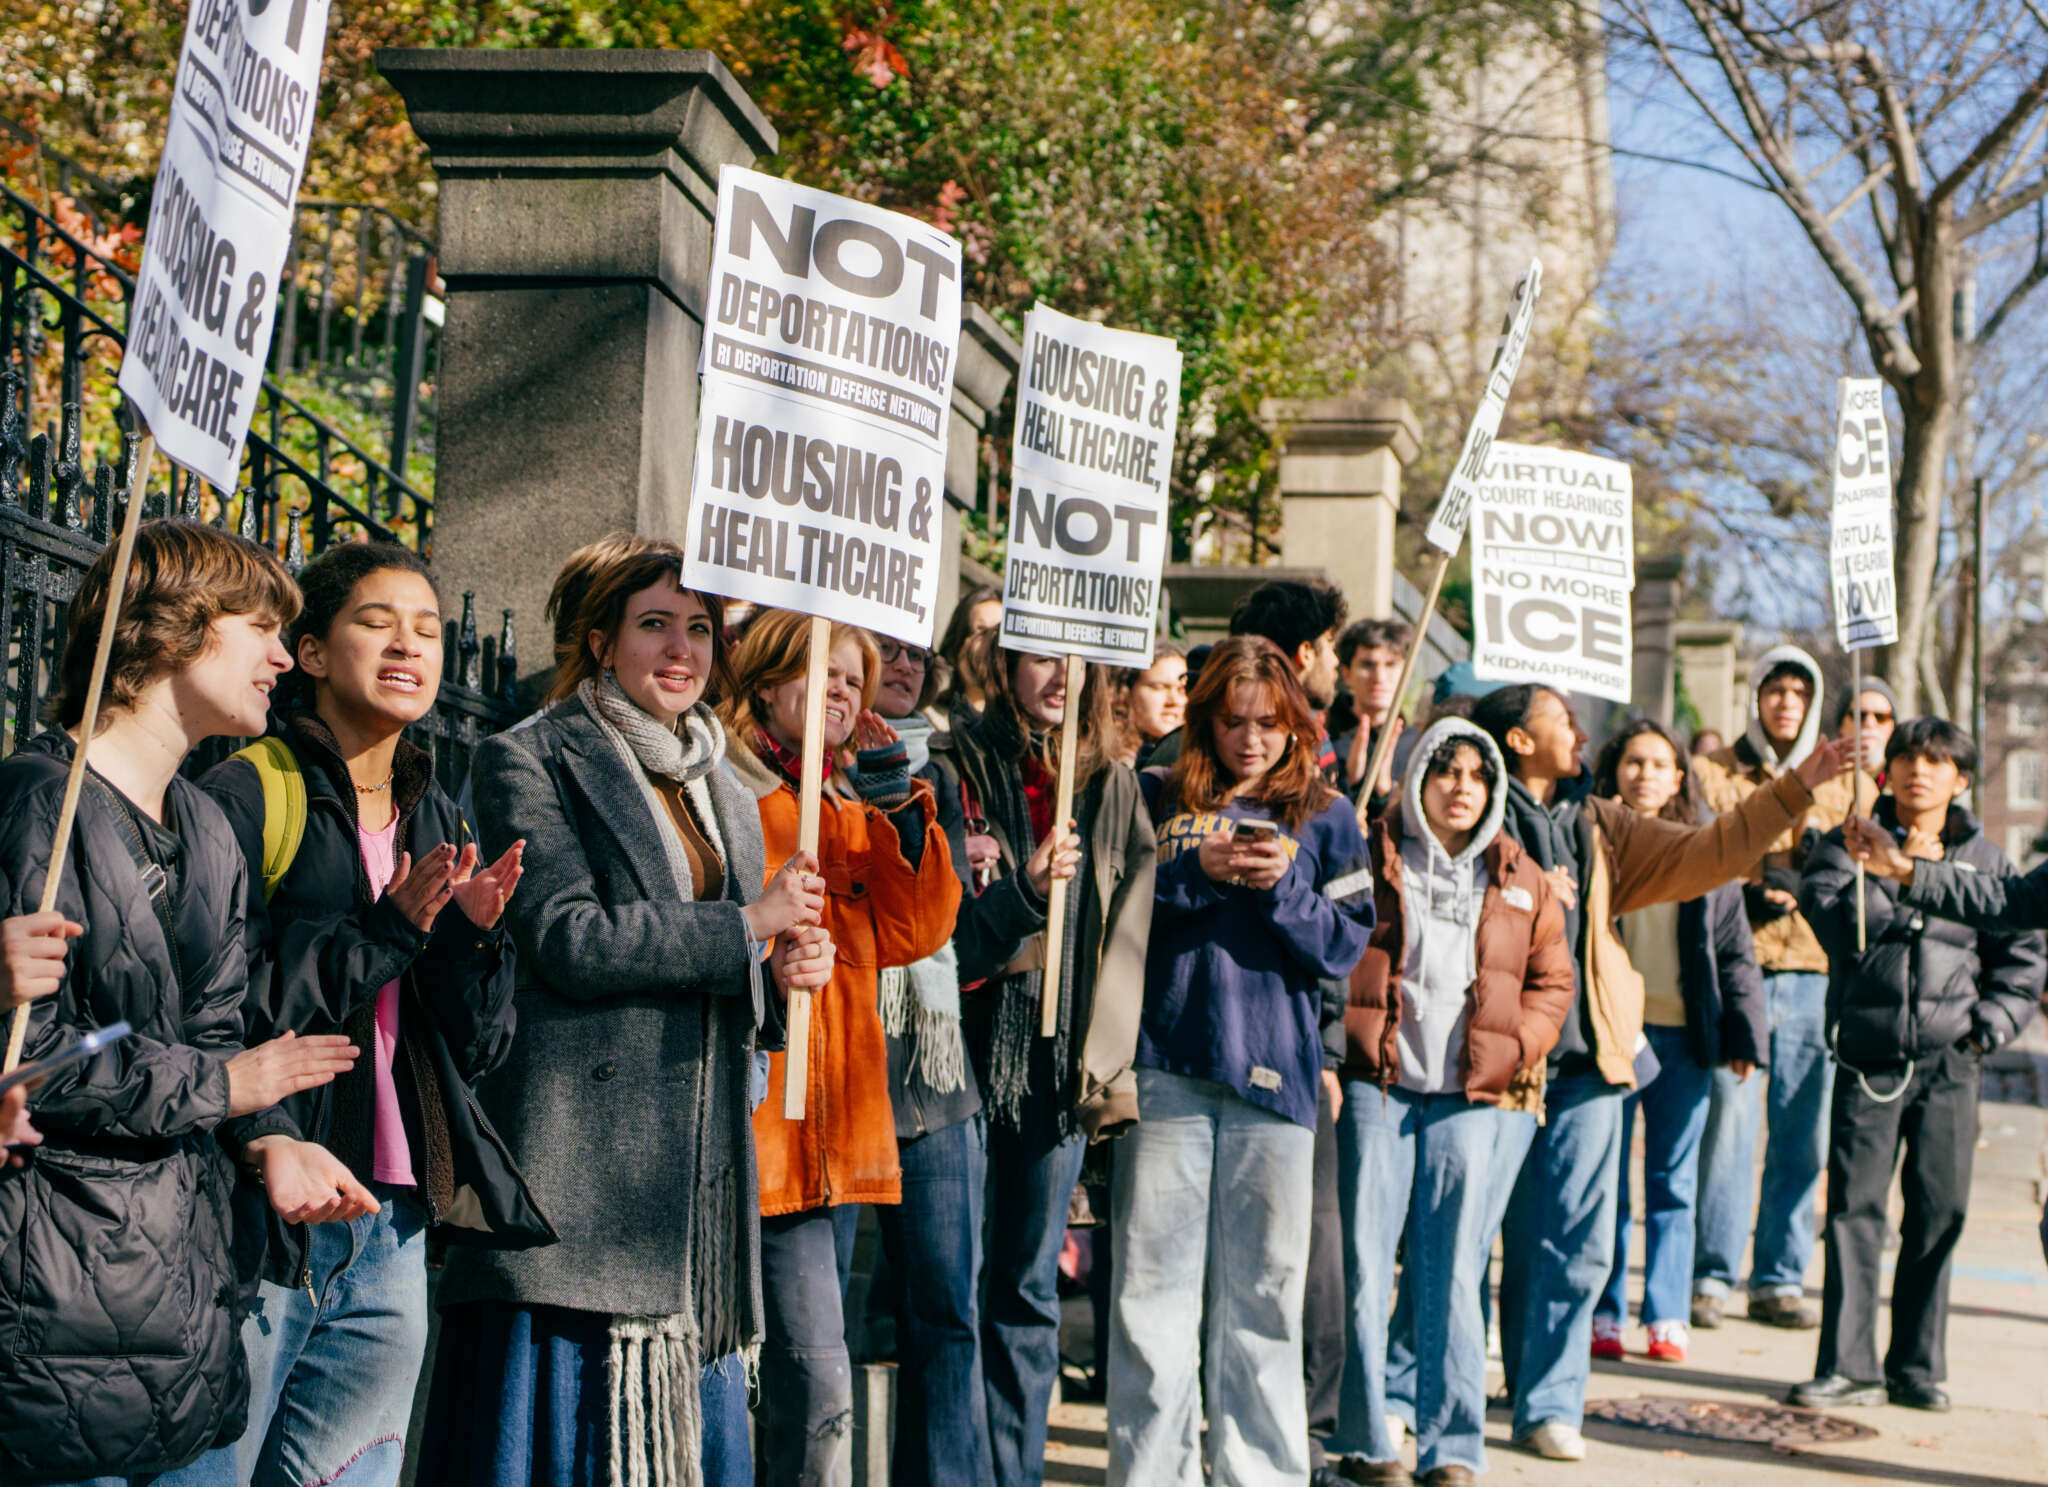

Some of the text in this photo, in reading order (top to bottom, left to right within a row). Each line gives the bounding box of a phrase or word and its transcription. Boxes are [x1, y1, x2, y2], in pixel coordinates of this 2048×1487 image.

[195, 0, 309, 153] DEPTIONS!
[728, 185, 956, 322] NOT
[235, 271, 266, 358] &
[718, 272, 950, 395] DEPORTATIONS!
[716, 342, 938, 433] RI DEPORTATION DEFENSE NETWORK
[1029, 331, 1168, 430] HOUSING &
[711, 415, 934, 544] HOUSING &
[1020, 400, 1162, 494] HEALTHCARE,
[1481, 461, 1625, 494] VIRTUAL
[1839, 418, 1885, 479] CE
[1014, 487, 1158, 563] NOT
[1478, 485, 1624, 518] COURT HEARINGS
[1482, 509, 1625, 556] NOW!
[698, 502, 925, 624] HEALTHCARE,
[1008, 558, 1154, 619] DEPORTATIONS!
[1482, 568, 1624, 608] NO MORE
[1064, 622, 1103, 645] DEFENSE
[1484, 593, 1624, 667] ICE
